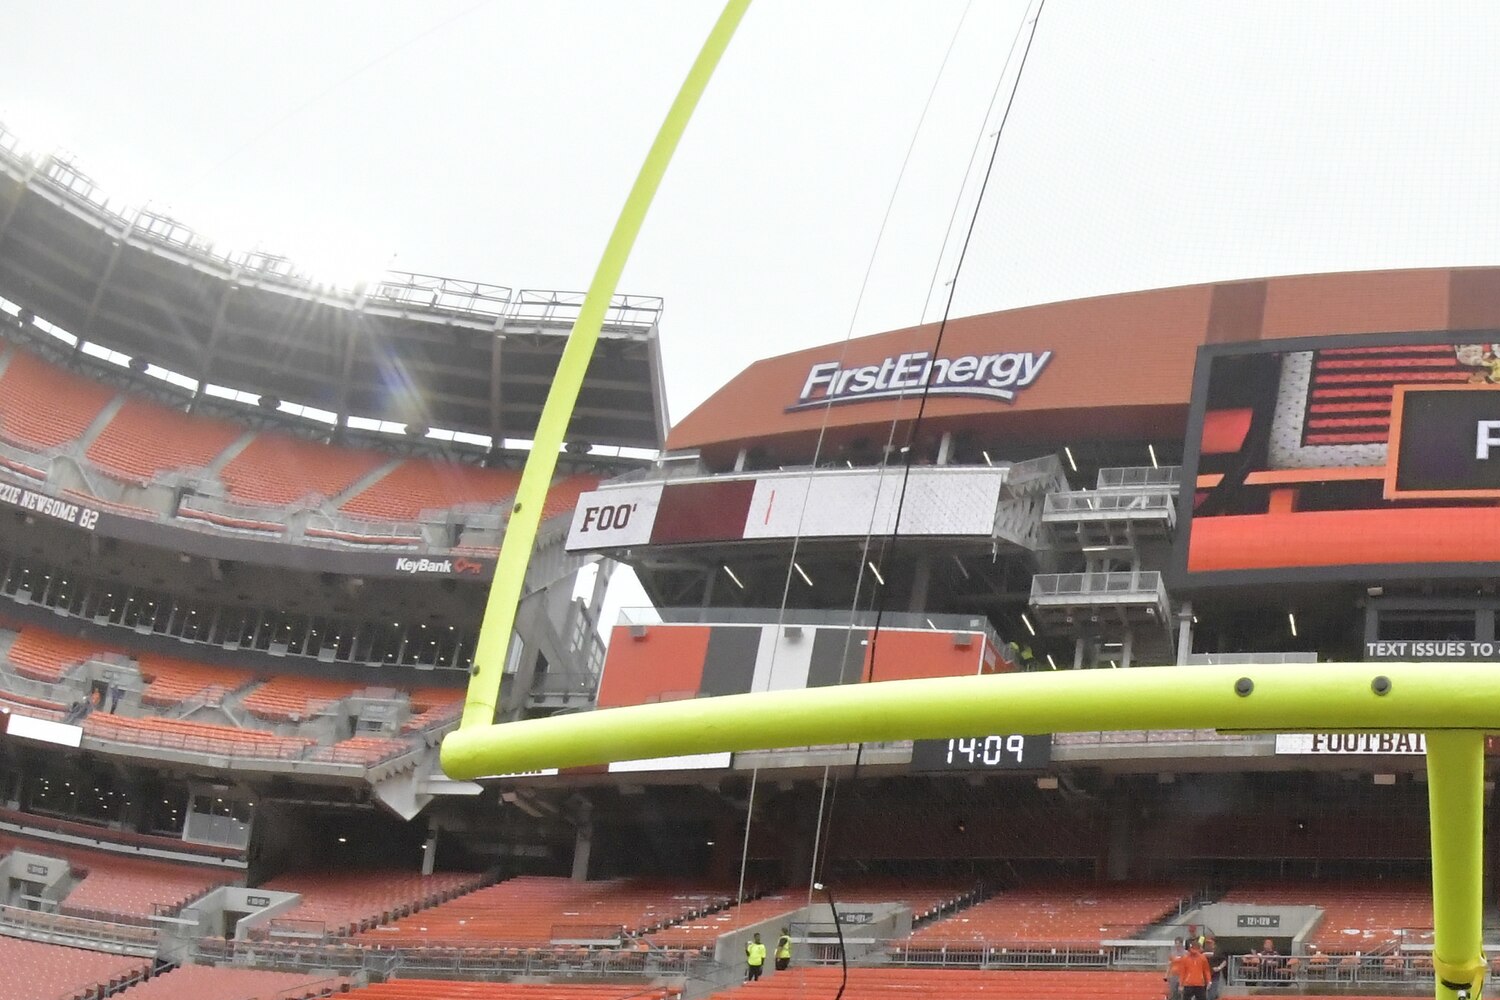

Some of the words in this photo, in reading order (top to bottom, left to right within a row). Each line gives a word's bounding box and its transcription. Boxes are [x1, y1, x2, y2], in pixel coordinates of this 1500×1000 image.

[800, 350, 1052, 400] FirstEnergy
[21, 490, 79, 523] NEWSOME
[79, 508, 99, 530] 82
[580, 503, 637, 533] FOO
[396, 557, 452, 574] KeyBank
[1366, 642, 1408, 657] TEXT
[1411, 642, 1466, 657] ISSUES
[1471, 642, 1494, 657] TO
[946, 734, 1024, 765] 14:09
